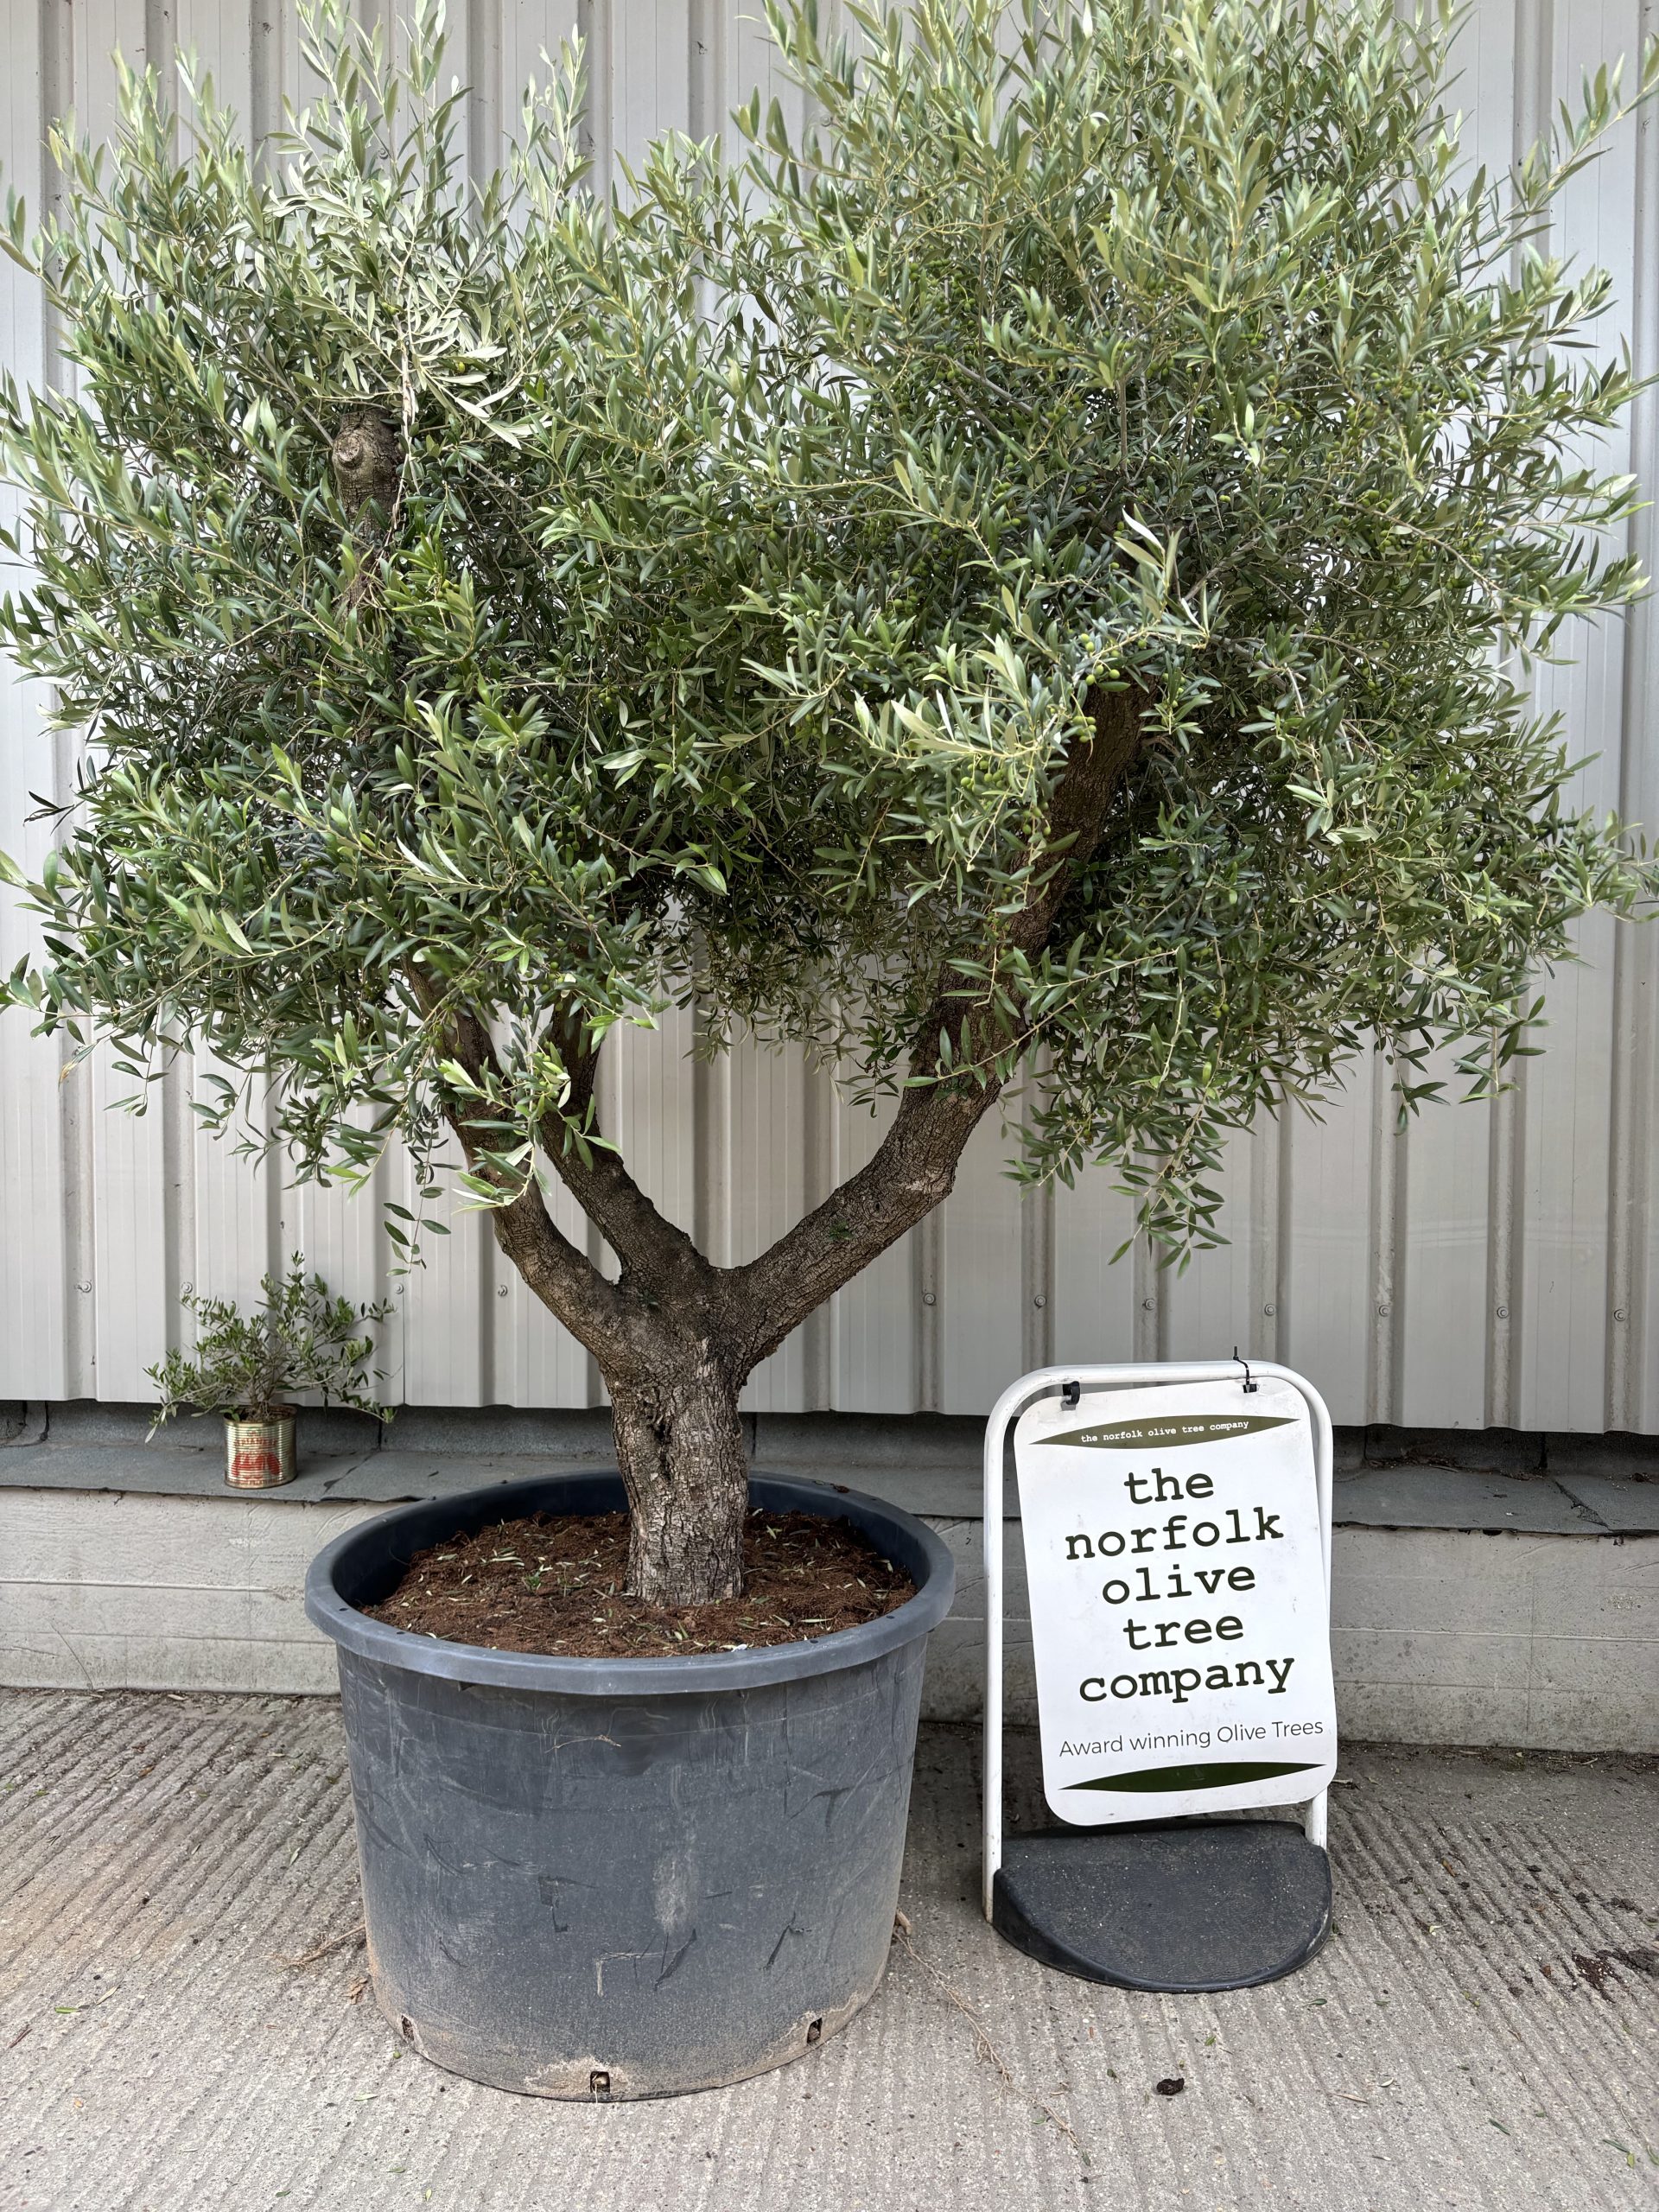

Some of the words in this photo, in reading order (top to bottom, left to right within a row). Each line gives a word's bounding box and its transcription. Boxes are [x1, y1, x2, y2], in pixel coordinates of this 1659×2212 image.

[1080, 1434, 1098, 1443] the
[1103, 1430, 1142, 1440] norfolk
[1147, 1427, 1177, 1436] olive
[1182, 1425, 1205, 1433] tree
[1210, 1421, 1249, 1431] company
[1124, 1468, 1213, 1504] the
[1065, 1507, 1283, 1560] norfolk
[1103, 1564, 1255, 1605] olive
[1123, 1616, 1243, 1649] tree
[1080, 1658, 1294, 1703] company
[1058, 1736, 1122, 1757] Award
[1130, 1730, 1210, 1750] winning
[1217, 1725, 1266, 1742] Olive
[1272, 1721, 1323, 1737] Trees
